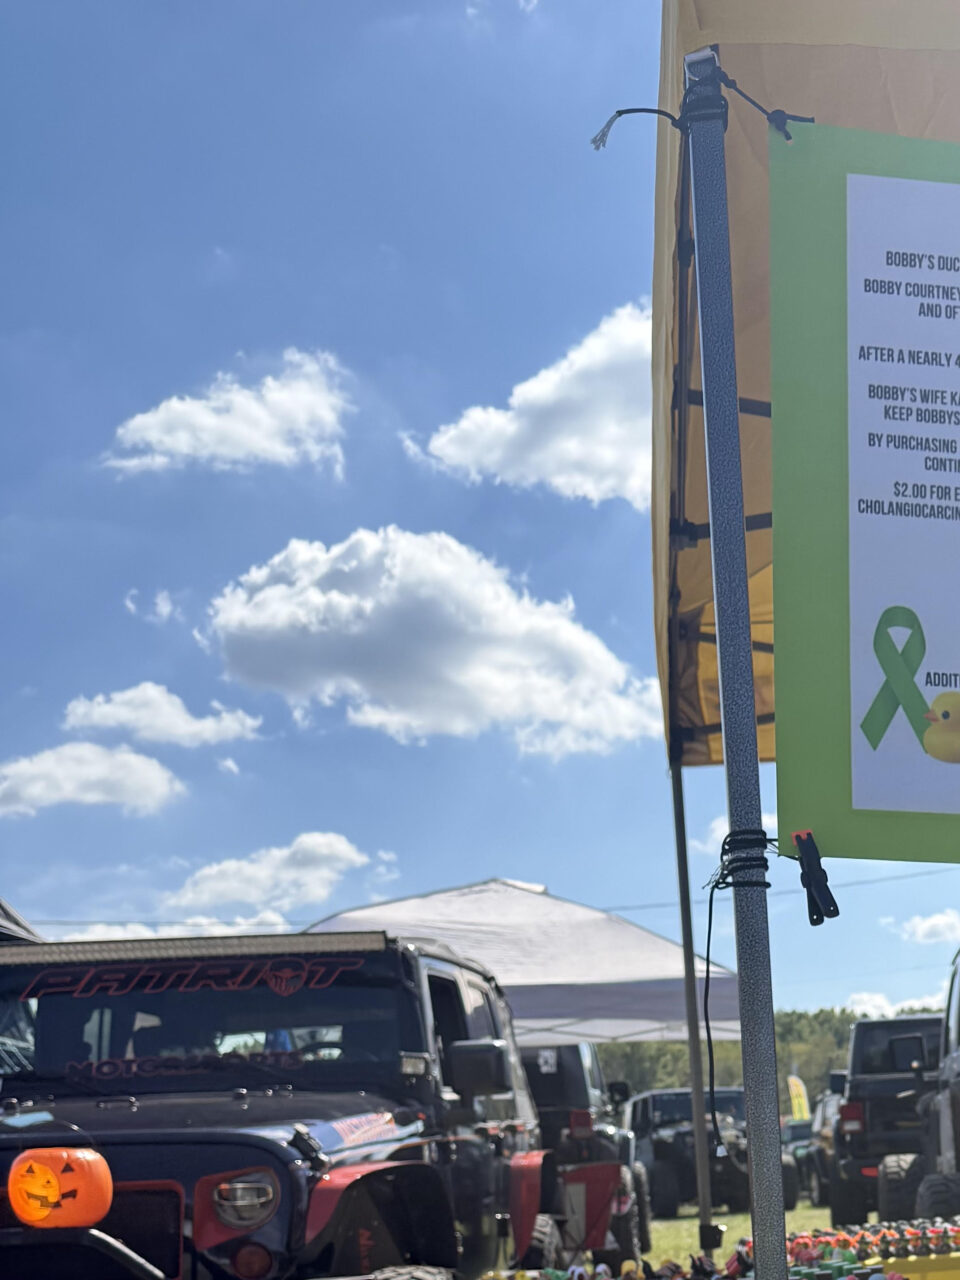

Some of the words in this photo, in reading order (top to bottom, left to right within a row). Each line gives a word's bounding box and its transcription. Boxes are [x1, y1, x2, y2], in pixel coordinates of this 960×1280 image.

[885, 251, 935, 270] BOBBY'S
[863, 278, 901, 296] BOBBY
[918, 303, 942, 319] AND
[858, 346, 894, 363] AFTER
[896, 349, 905, 364] A
[907, 350, 951, 368] NEARLY
[868, 385, 917, 403] BOBBY'S
[919, 389, 947, 406] WIFE
[893, 482, 927, 500] $2.00
[929, 485, 951, 501] FOR
